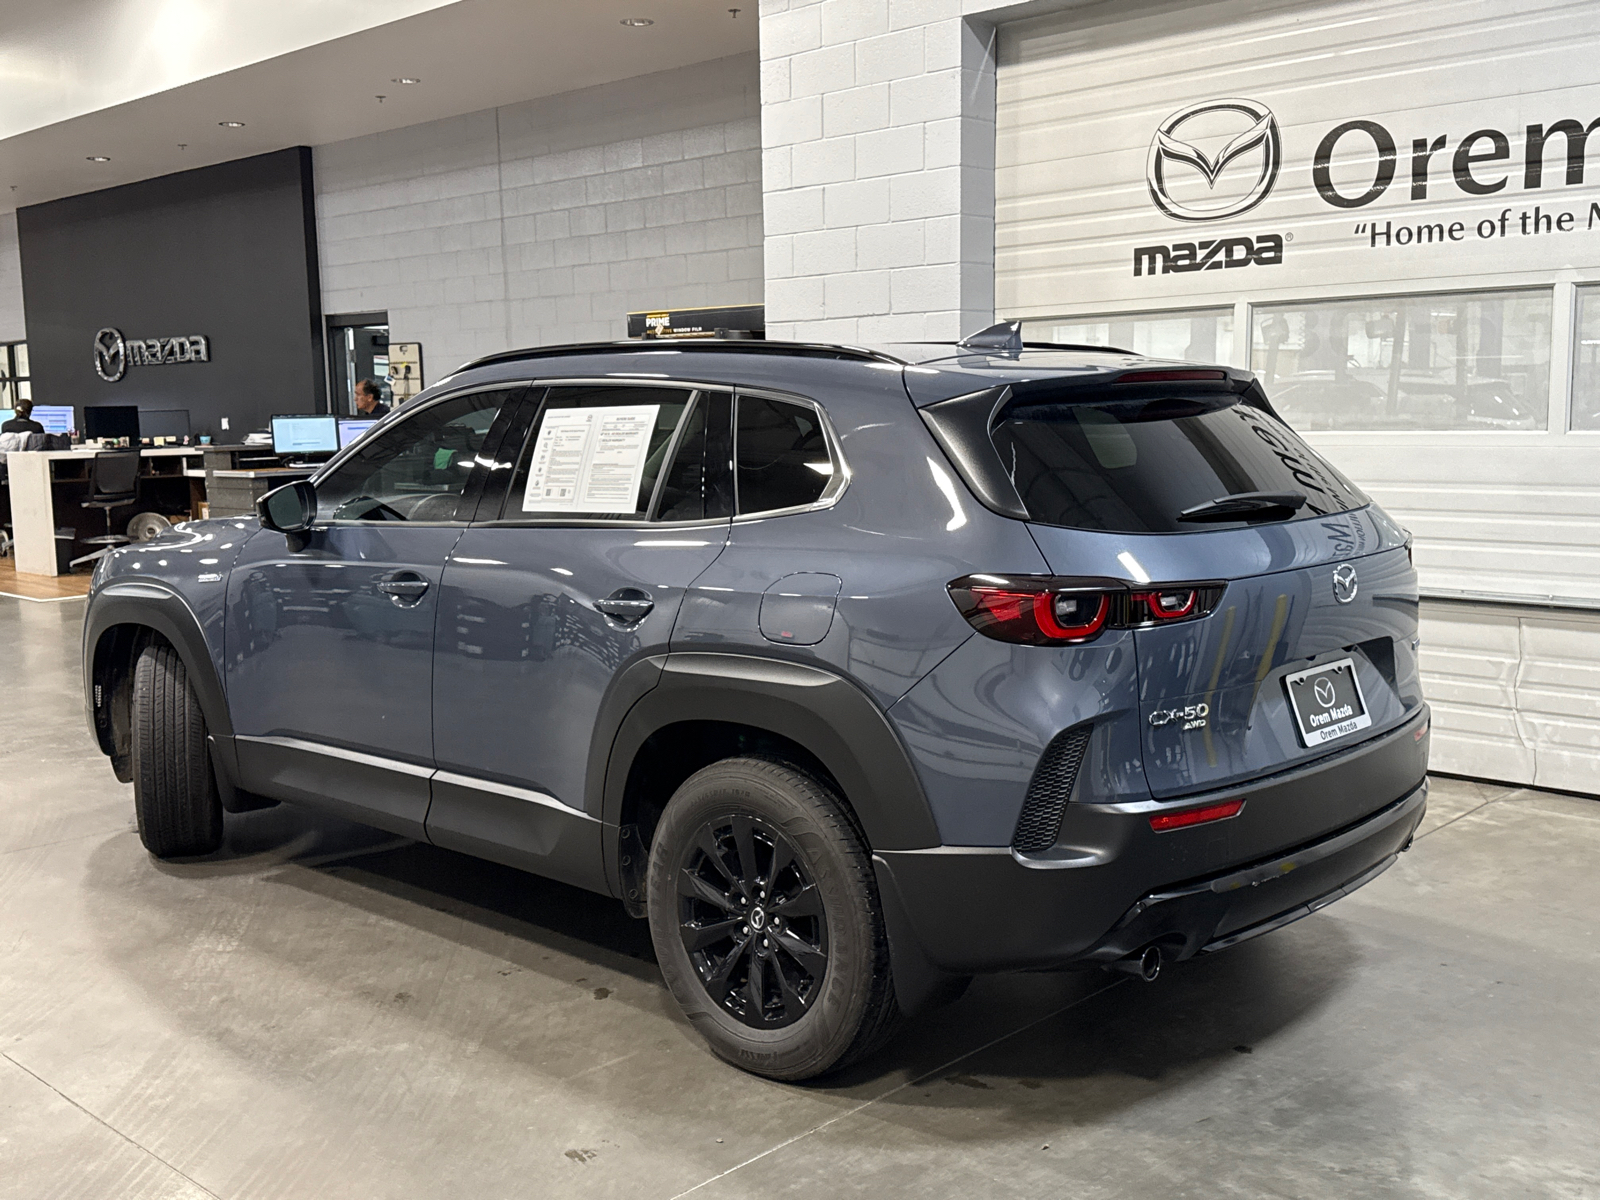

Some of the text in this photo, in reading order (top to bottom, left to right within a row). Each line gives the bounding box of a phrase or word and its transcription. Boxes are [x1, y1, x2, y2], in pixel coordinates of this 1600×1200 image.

[1312, 119, 1600, 208] Orem
[1476, 208, 1512, 239] of
[1519, 206, 1574, 235] the
[645, 316, 670, 328] PRIME
[1148, 703, 1209, 726] CX-50
[1183, 719, 1206, 731] AWD
[1309, 703, 1354, 728] Orem Mazda
[1320, 721, 1358, 741] Orem Mazda
